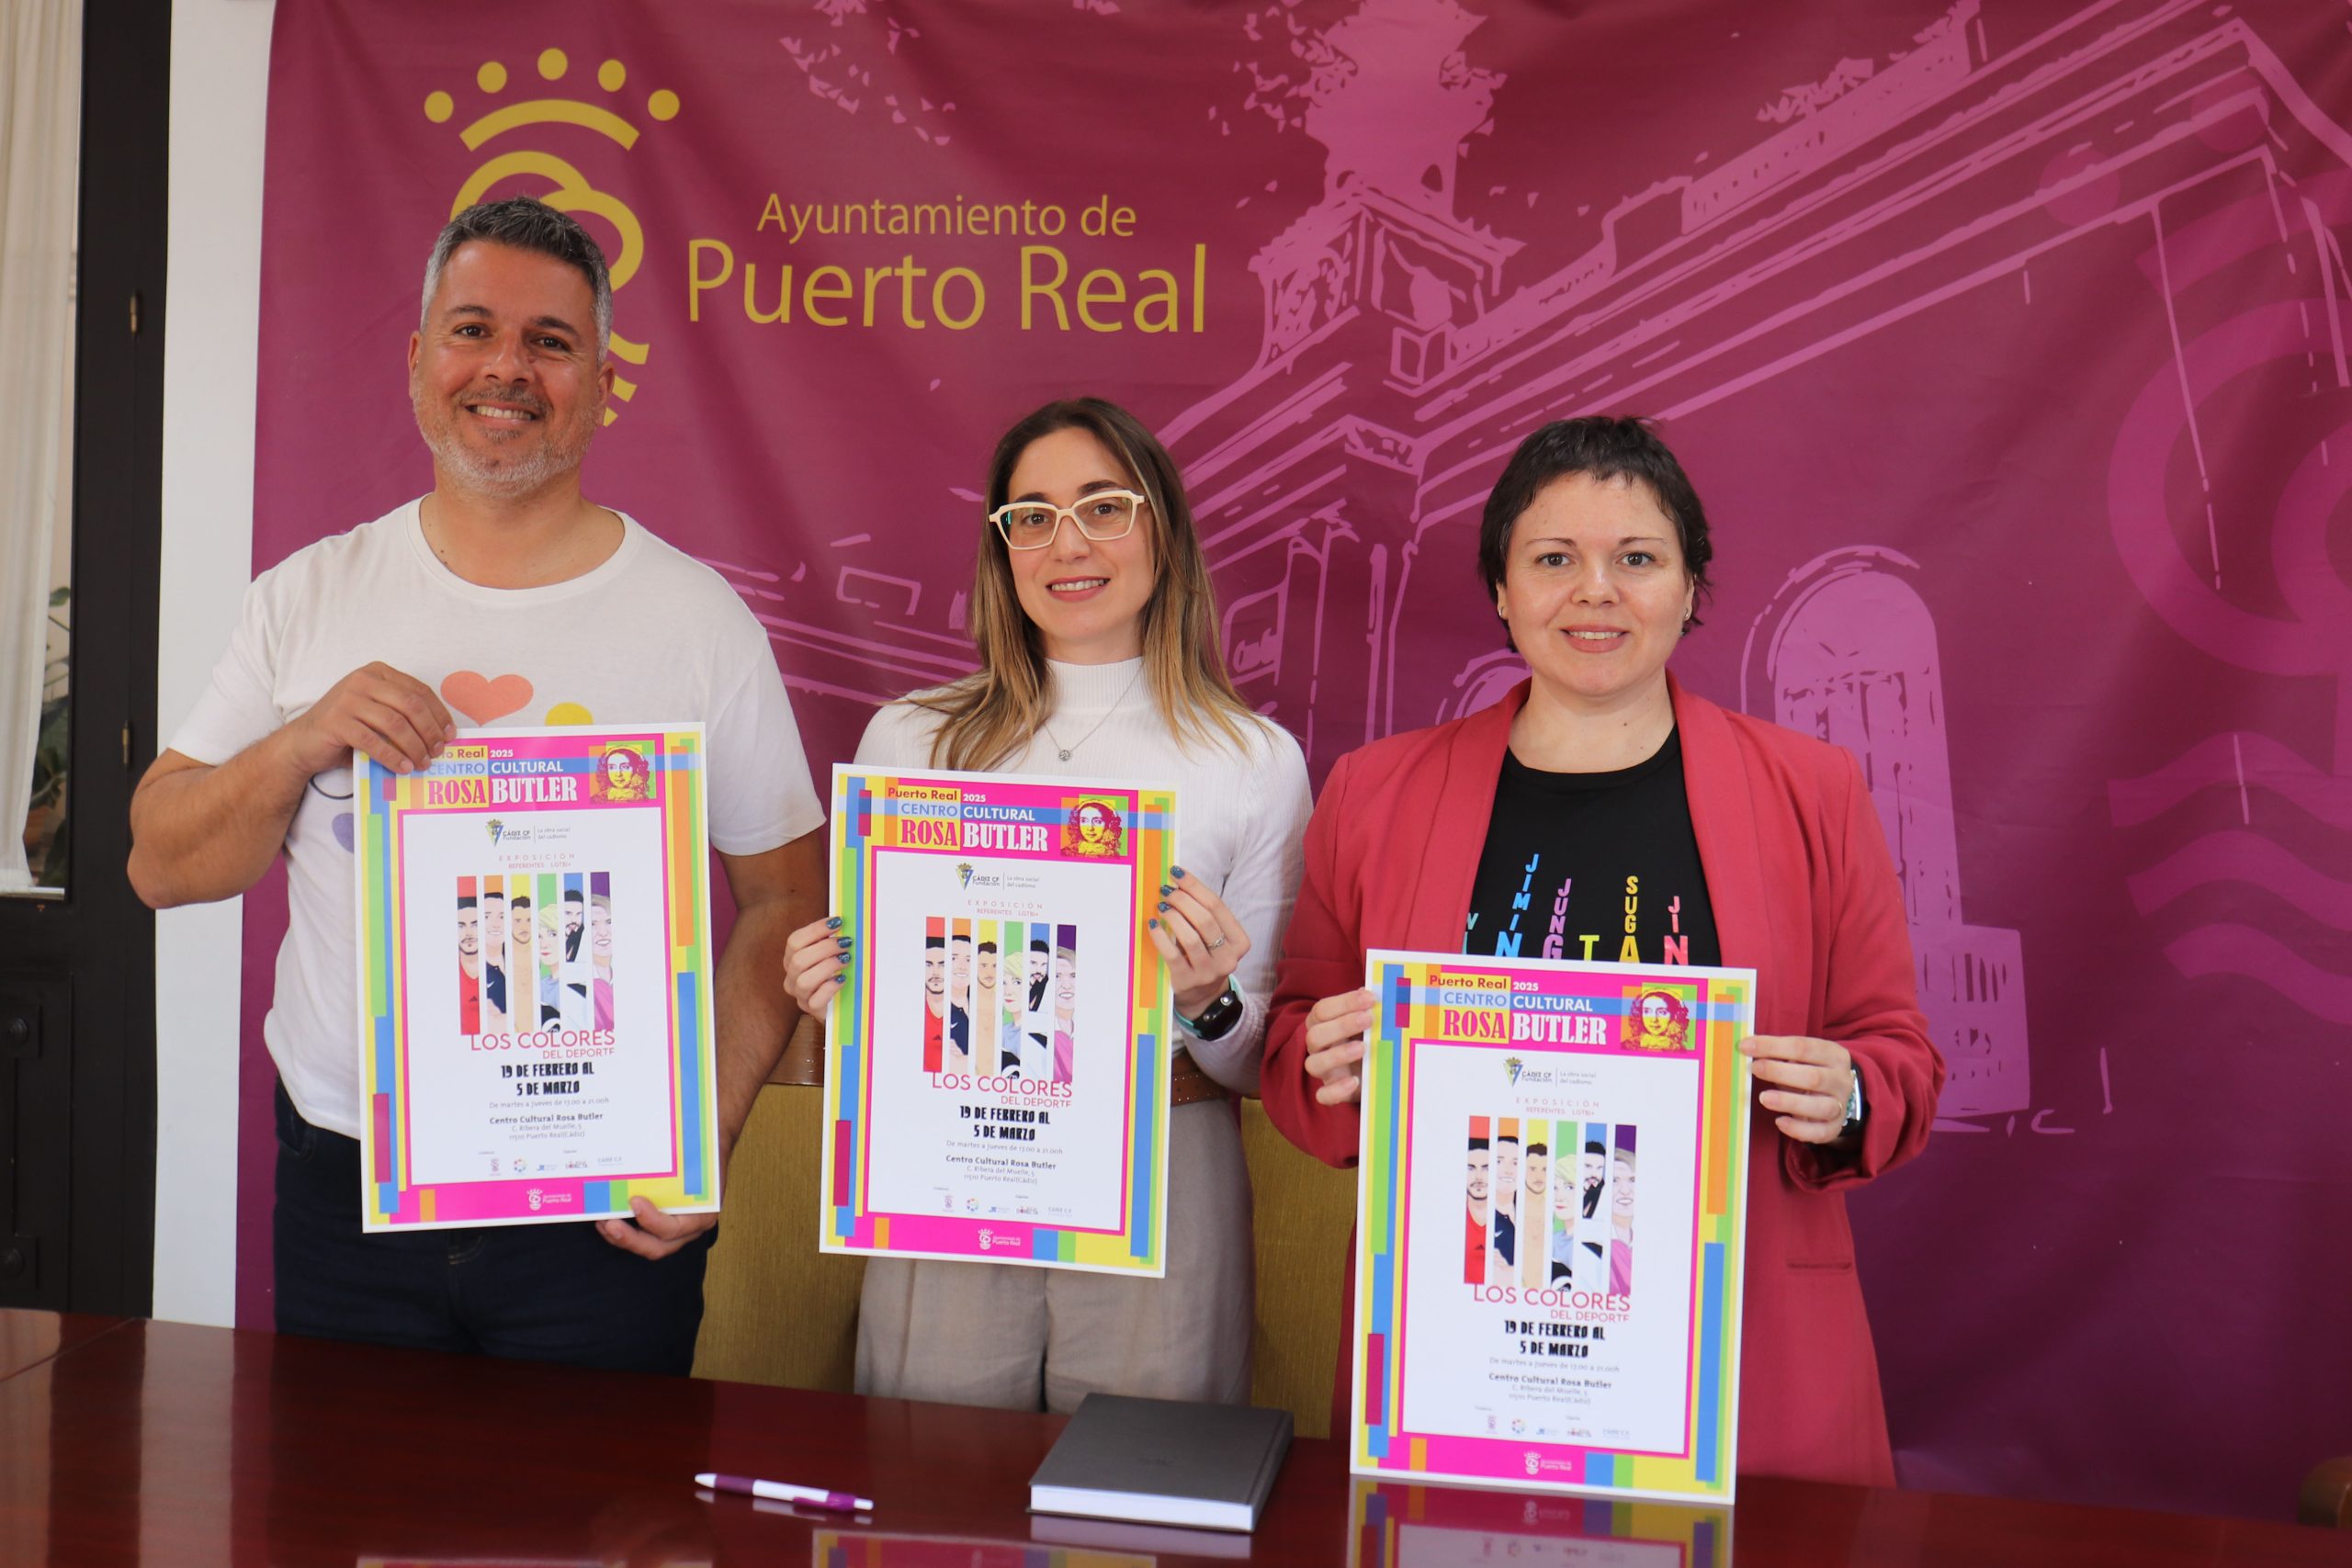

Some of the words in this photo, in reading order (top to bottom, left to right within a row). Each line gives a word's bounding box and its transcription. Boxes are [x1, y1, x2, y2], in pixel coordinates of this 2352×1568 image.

[757, 193, 1066, 244] Ayuntamiento
[1080, 195, 1136, 237] de
[688, 239, 985, 330] Puerto
[1021, 244, 1205, 333] Real
[458, 748, 484, 759] Real
[428, 762, 485, 775] CENTRO
[492, 761, 563, 773] CULTURAL
[428, 779, 486, 805] ROSA
[492, 777, 577, 803] BUTLER
[888, 788, 927, 799] Puerto
[932, 790, 956, 800] Real
[963, 794, 986, 802] 2025
[901, 803, 957, 817] CENTRO
[964, 807, 1035, 821] CULTURAL
[900, 819, 957, 846] ROSA
[963, 822, 1047, 852] BUTLER
[1430, 975, 1473, 988] Puerto
[1477, 977, 1507, 989] Real
[1513, 981, 1538, 991] 2025
[1444, 992, 1507, 1007] CENTRO
[1514, 996, 1593, 1011] CULTURAL
[1442, 1010, 1507, 1039] ROSA
[1512, 1012, 1607, 1045] BUTLER
[471, 1033, 511, 1051] LOS
[518, 1030, 615, 1049] COLORES
[543, 1050, 562, 1059] DEL
[501, 1065, 512, 1077] 19
[516, 1065, 529, 1077] DE
[534, 1063, 578, 1077] FEBRERO
[582, 1062, 594, 1075] AL
[517, 1083, 522, 1096] 5
[526, 1082, 538, 1095] DE
[543, 1081, 580, 1094] MARZO
[933, 1071, 970, 1090] LOS
[978, 1076, 1072, 1098] COLORES
[1001, 1096, 1020, 1105] DEL
[960, 1106, 970, 1118] 19
[975, 1106, 987, 1120] DE
[990, 1108, 1035, 1123] FEBRERO
[1039, 1111, 1050, 1124] AL
[974, 1125, 979, 1137] 5
[983, 1126, 995, 1138] DE
[1000, 1126, 1035, 1141] MARZO
[976, 1157, 1008, 1166] Cultural
[1032, 1161, 1056, 1169] Butler
[1475, 1284, 1516, 1303] LOS
[1524, 1288, 1631, 1312] COLORES
[1551, 1310, 1571, 1320] DEL
[1504, 1320, 1516, 1333] 19
[1521, 1321, 1534, 1335] DE
[1539, 1323, 1588, 1338] FEBRERO
[1592, 1326, 1605, 1340] AL
[1521, 1341, 1526, 1354] 5
[1531, 1341, 1544, 1355] DE
[1549, 1342, 1588, 1358] MARZO
